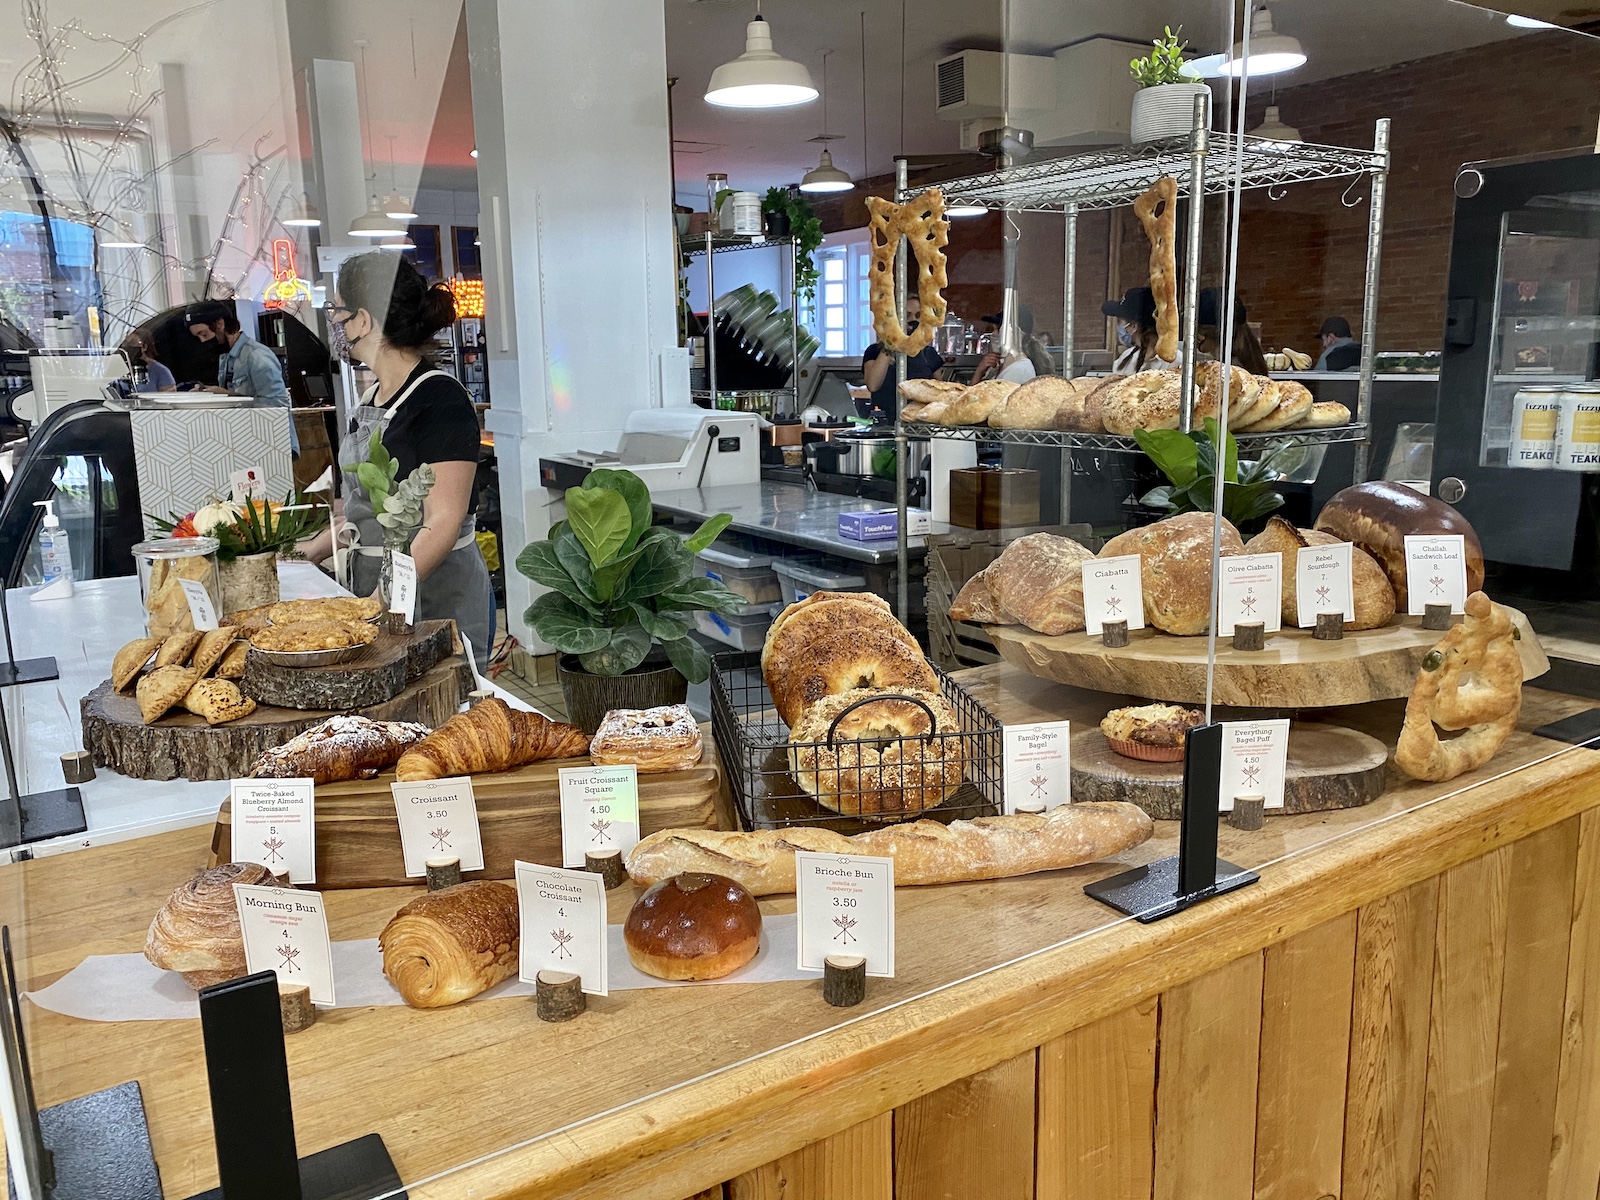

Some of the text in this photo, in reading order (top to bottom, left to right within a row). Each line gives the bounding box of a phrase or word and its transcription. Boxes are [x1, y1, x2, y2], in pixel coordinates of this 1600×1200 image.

[1525, 402, 1548, 411] fizzy
[1577, 403, 1600, 413] fizzy
[1571, 454, 1600, 463] TEAK
[864, 524, 893, 533] TouchFlex
[1315, 554, 1333, 562] Rebel
[1307, 561, 1340, 571] Sourdough
[1433, 563, 1441, 571] 8.
[1094, 569, 1129, 578] Ciabatta
[1321, 573, 1328, 581] 7.
[1017, 733, 1058, 742] Family-Style
[1234, 729, 1273, 737] Everything
[1235, 735, 1271, 745] Bagel Puff
[1028, 741, 1048, 750] Bagel
[1243, 756, 1260, 764] 4.50
[1035, 762, 1044, 771] 6.
[568, 775, 629, 786] Fruit Croissant
[250, 790, 296, 798] Twice-Baked
[584, 785, 614, 795] Square
[410, 794, 458, 805] Croissant
[257, 805, 289, 813] Croissant
[590, 805, 611, 815] 4.50
[426, 809, 448, 819] 3.50
[269, 826, 279, 835] 5.
[815, 866, 874, 879] Brioche Bun
[535, 879, 582, 894] Chocolate
[539, 890, 582, 904] Croissant
[244, 896, 318, 914] Morning Bun
[832, 896, 857, 908] 3.50
[263, 913, 288, 921] cinnamon
[558, 907, 568, 918] 4.
[282, 929, 293, 939] 4.
